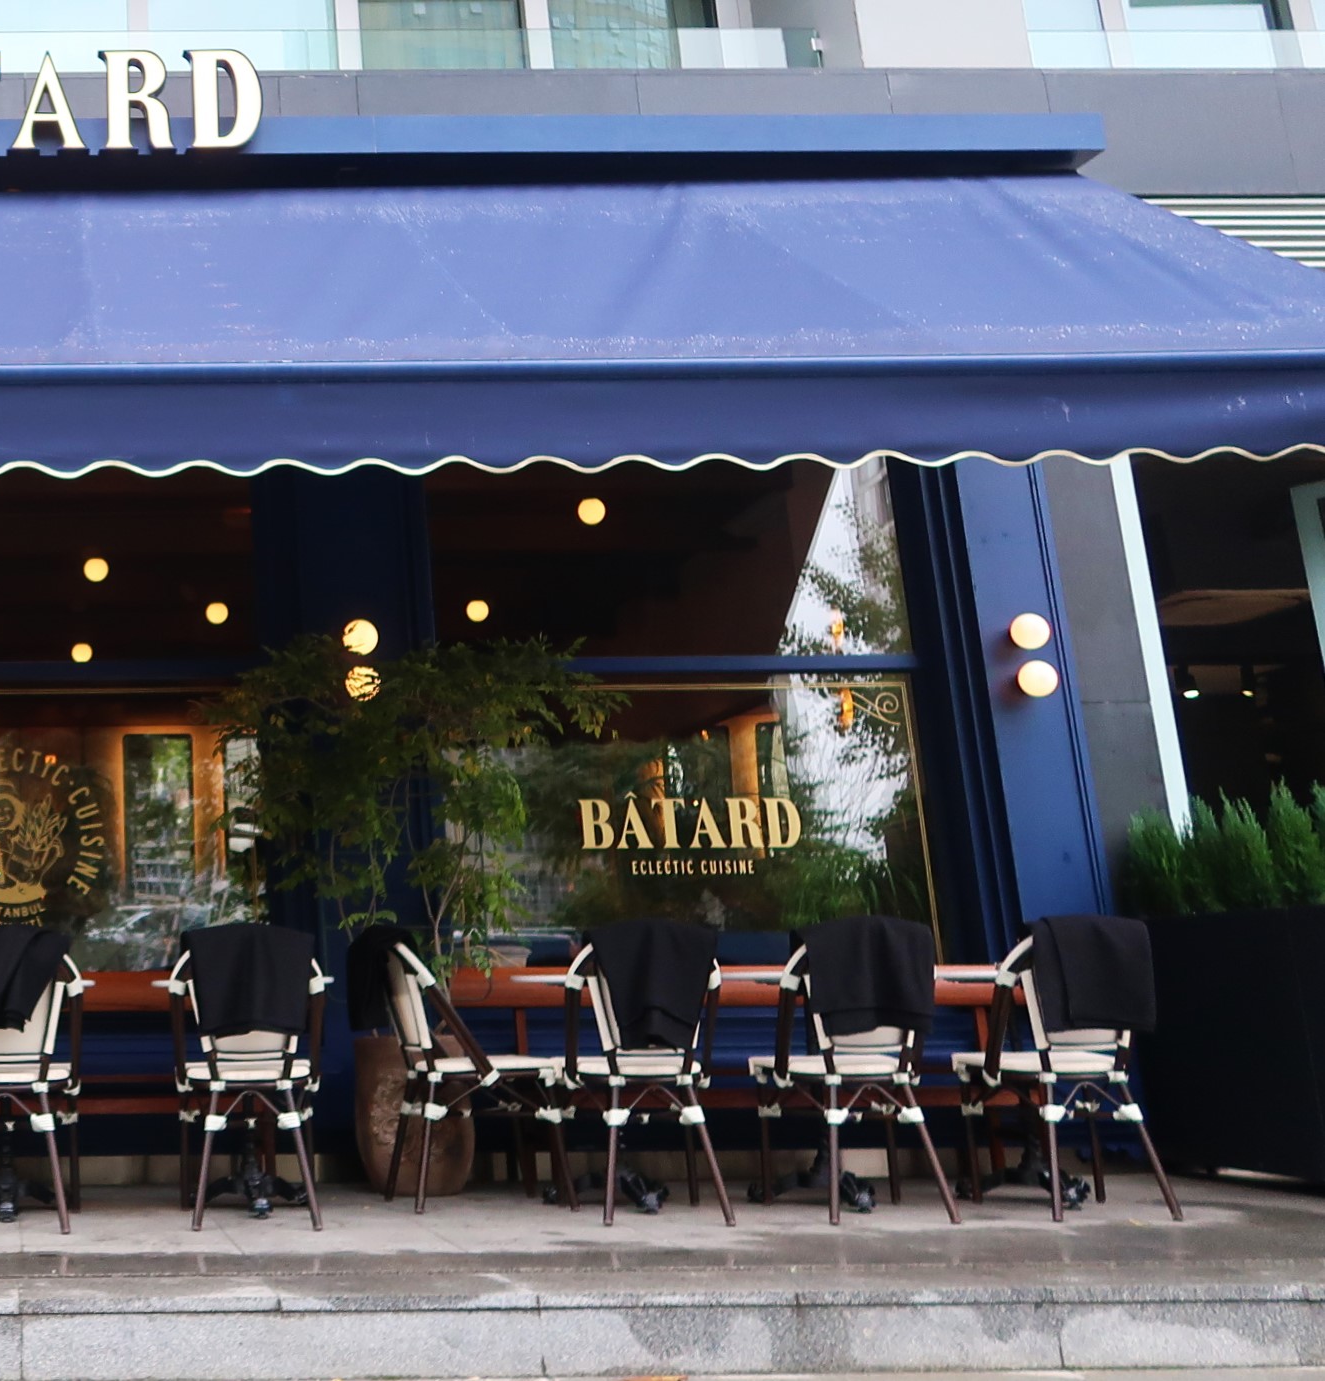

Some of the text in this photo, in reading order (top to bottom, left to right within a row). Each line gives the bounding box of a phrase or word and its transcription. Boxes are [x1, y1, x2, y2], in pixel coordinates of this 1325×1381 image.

[66, 786, 105, 895] CUISINE
[578, 791, 802, 849] BÂTARD
[632, 859, 755, 875] ECLECTIC CUISINE
